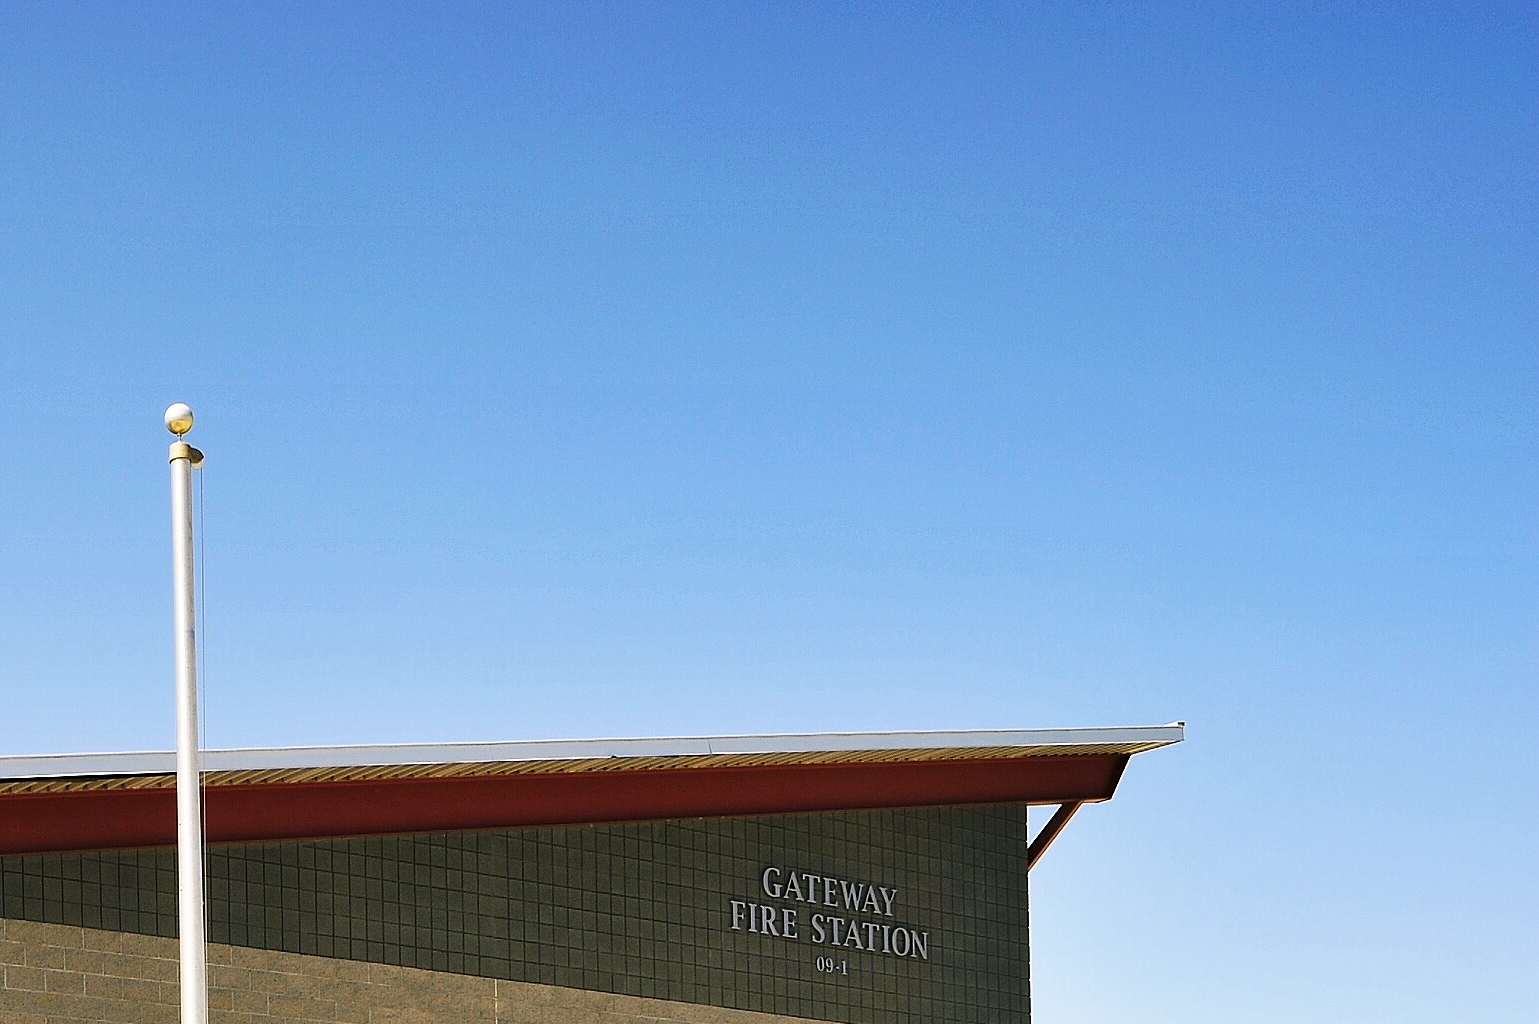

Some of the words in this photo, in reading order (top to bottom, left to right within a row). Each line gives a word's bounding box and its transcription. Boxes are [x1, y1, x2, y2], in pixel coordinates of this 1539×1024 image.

[763, 867, 897, 916] GATEWAY
[730, 900, 798, 938] FIRE
[812, 913, 929, 960] STATION
[816, 956, 848, 975] 09-1
